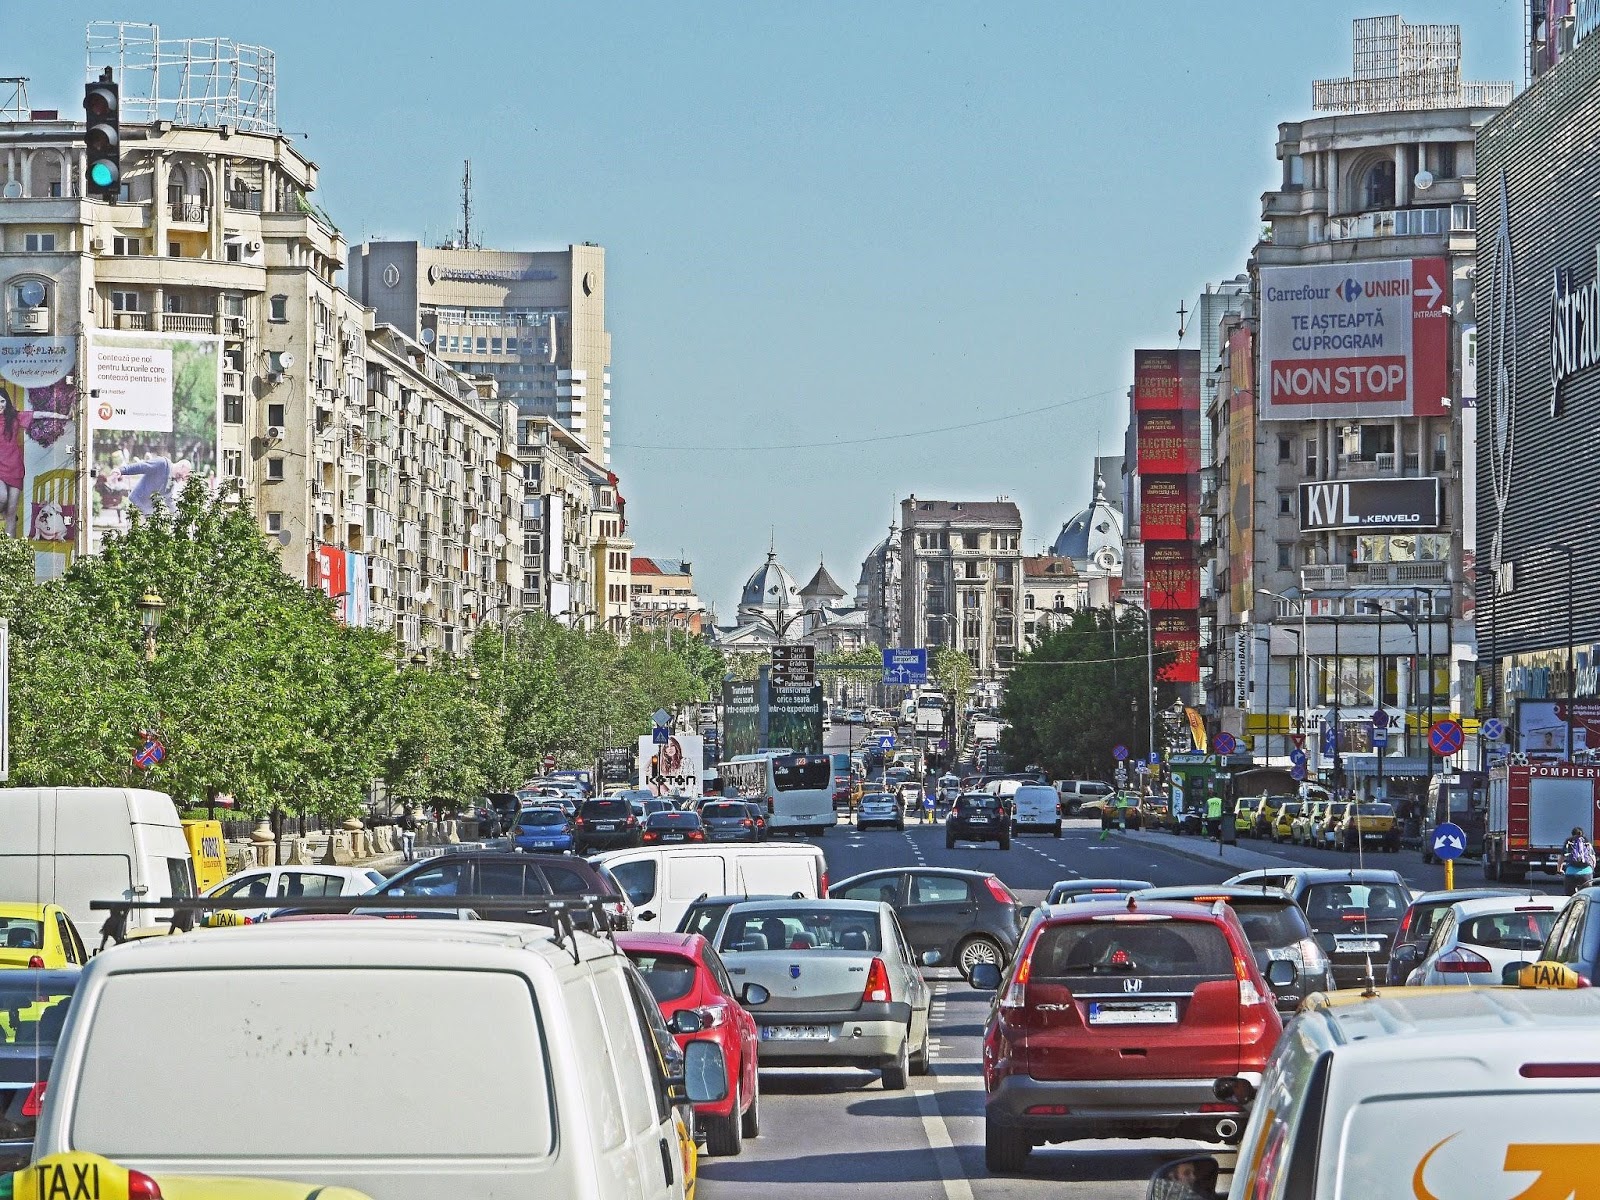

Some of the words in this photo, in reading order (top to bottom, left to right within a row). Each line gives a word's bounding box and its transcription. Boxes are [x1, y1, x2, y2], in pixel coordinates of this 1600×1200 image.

[1267, 285, 1331, 302] Carrefour
[1365, 279, 1410, 297] UNIRII
[1291, 315, 1309, 330] TE
[1311, 308, 1384, 334] AȘTEAPTĂ
[1414, 311, 1443, 319] INTRARE
[1292, 337, 1311, 351] CU
[1313, 334, 1383, 350] PROGRAM
[141, 355, 152, 363] noi
[121, 364, 149, 373] lucrurile
[154, 375, 167, 383] tine
[1273, 368, 1331, 396] NON
[1334, 364, 1404, 395] STOP
[1308, 483, 1359, 525] KVL
[1367, 514, 1420, 523] KENVELO
[776, 695, 792, 703] orice
[793, 695, 810, 703] seară
[1530, 767, 1600, 777] POMPIERI
[216, 913, 236, 926] TAXI
[1532, 965, 1565, 985] TAXI
[36, 1163, 100, 1200] TAXI
